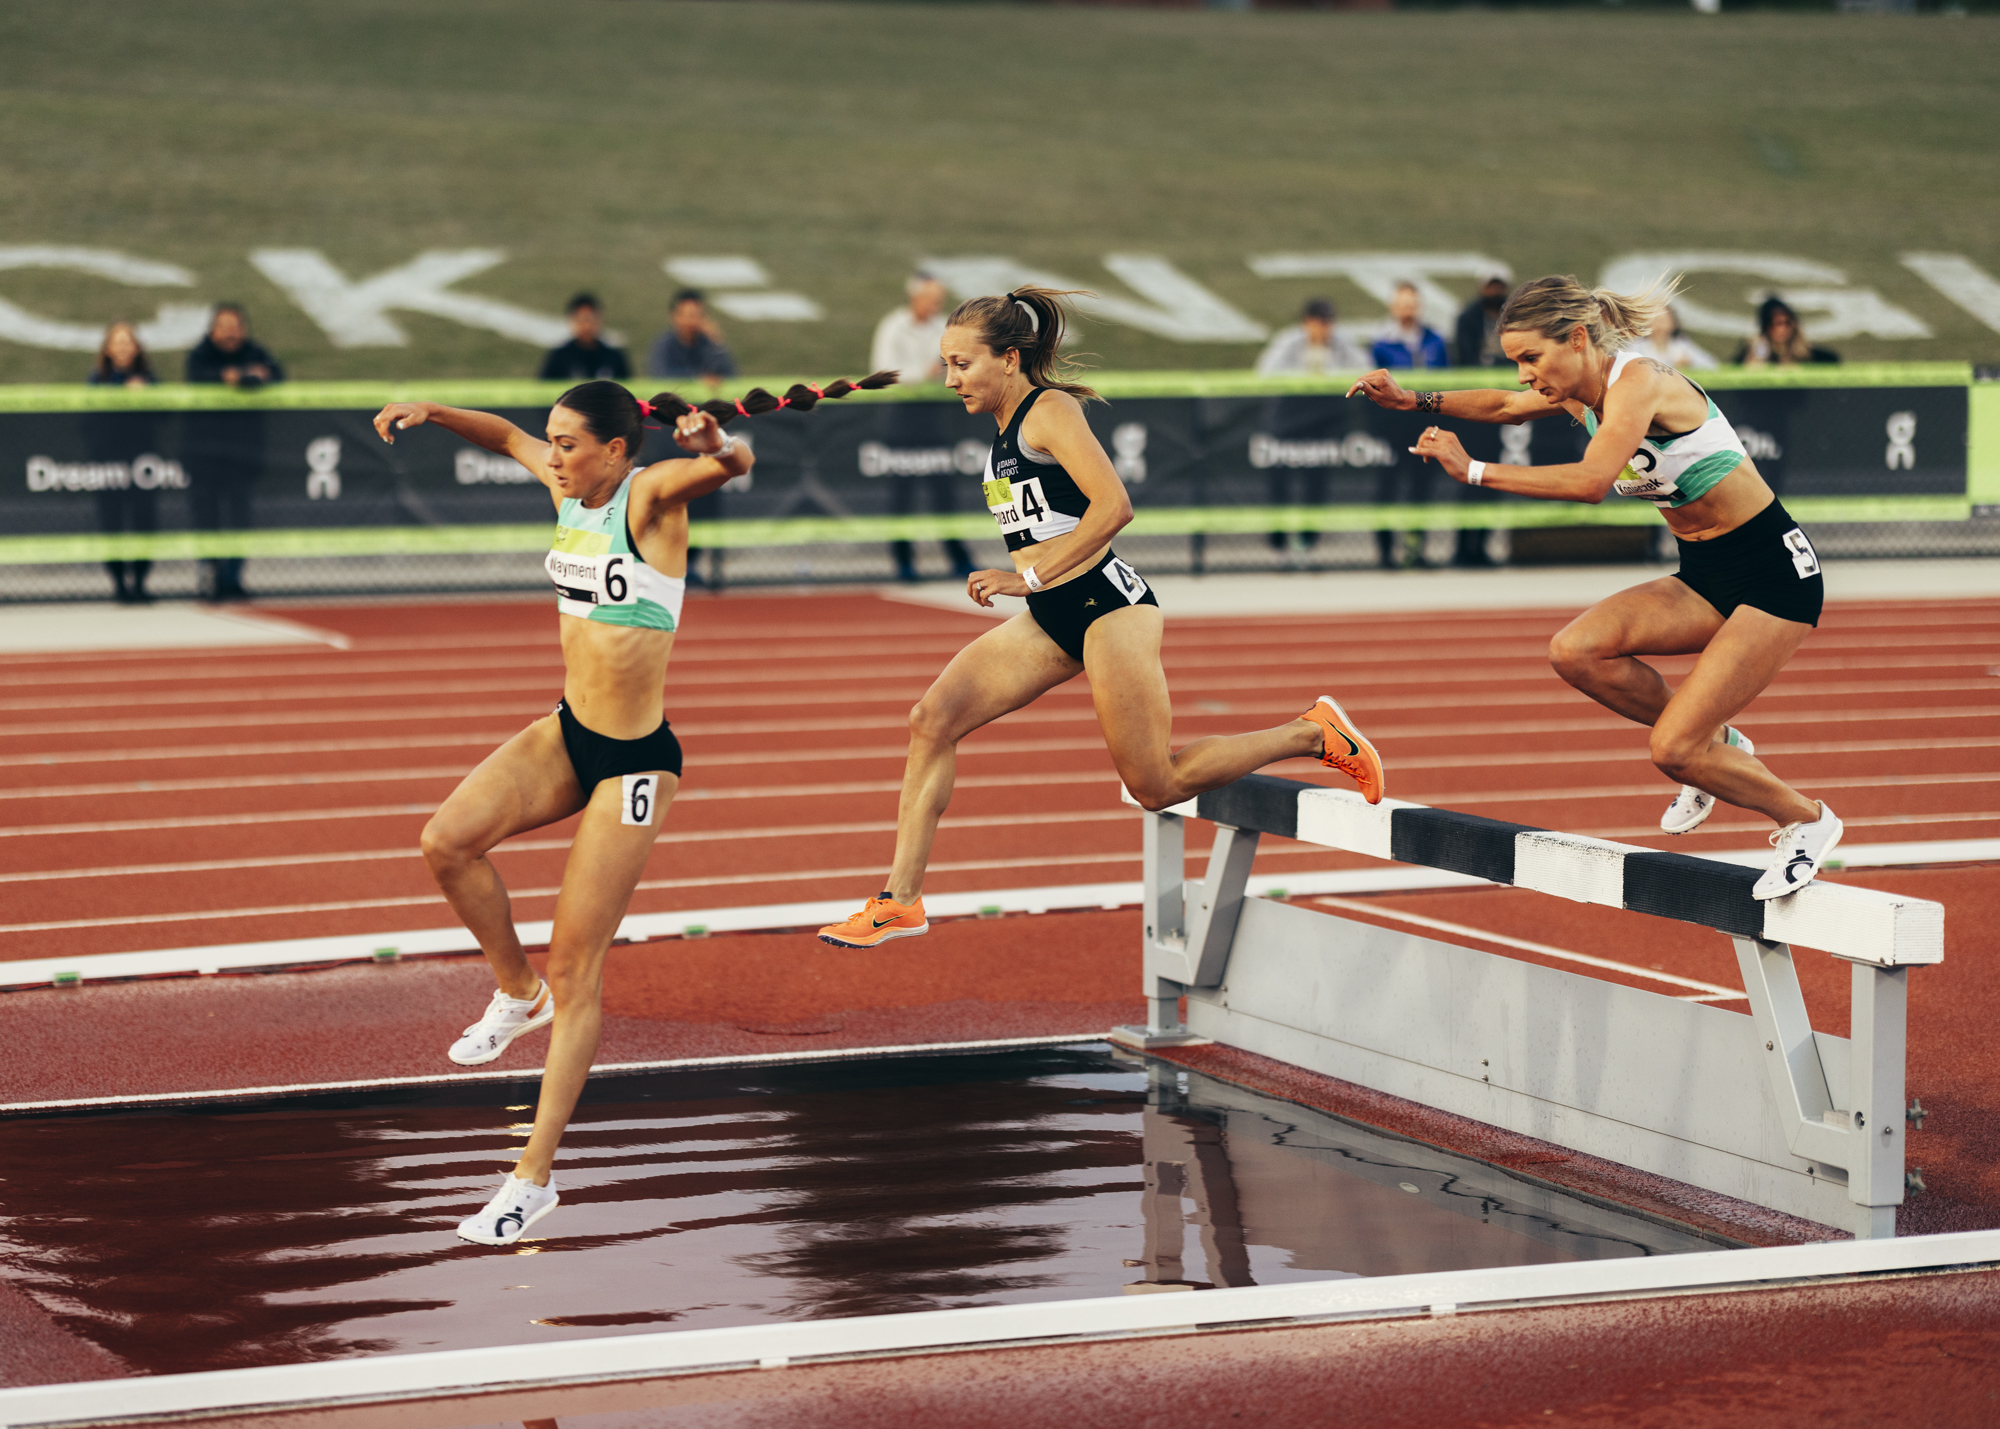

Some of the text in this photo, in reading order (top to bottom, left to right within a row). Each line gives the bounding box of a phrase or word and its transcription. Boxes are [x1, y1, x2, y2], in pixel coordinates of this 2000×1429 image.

[454, 448, 542, 486] Drea
[857, 441, 953, 477] Dream
[1249, 432, 1342, 469] Dream
[26, 454, 131, 492] Dream
[1001, 466, 1019, 477] AFOOT
[1022, 483, 1044, 523] 4
[1788, 532, 1817, 574] 5
[605, 557, 628, 603] 6
[1113, 561, 1144, 594] 4
[631, 778, 650, 823] 6
